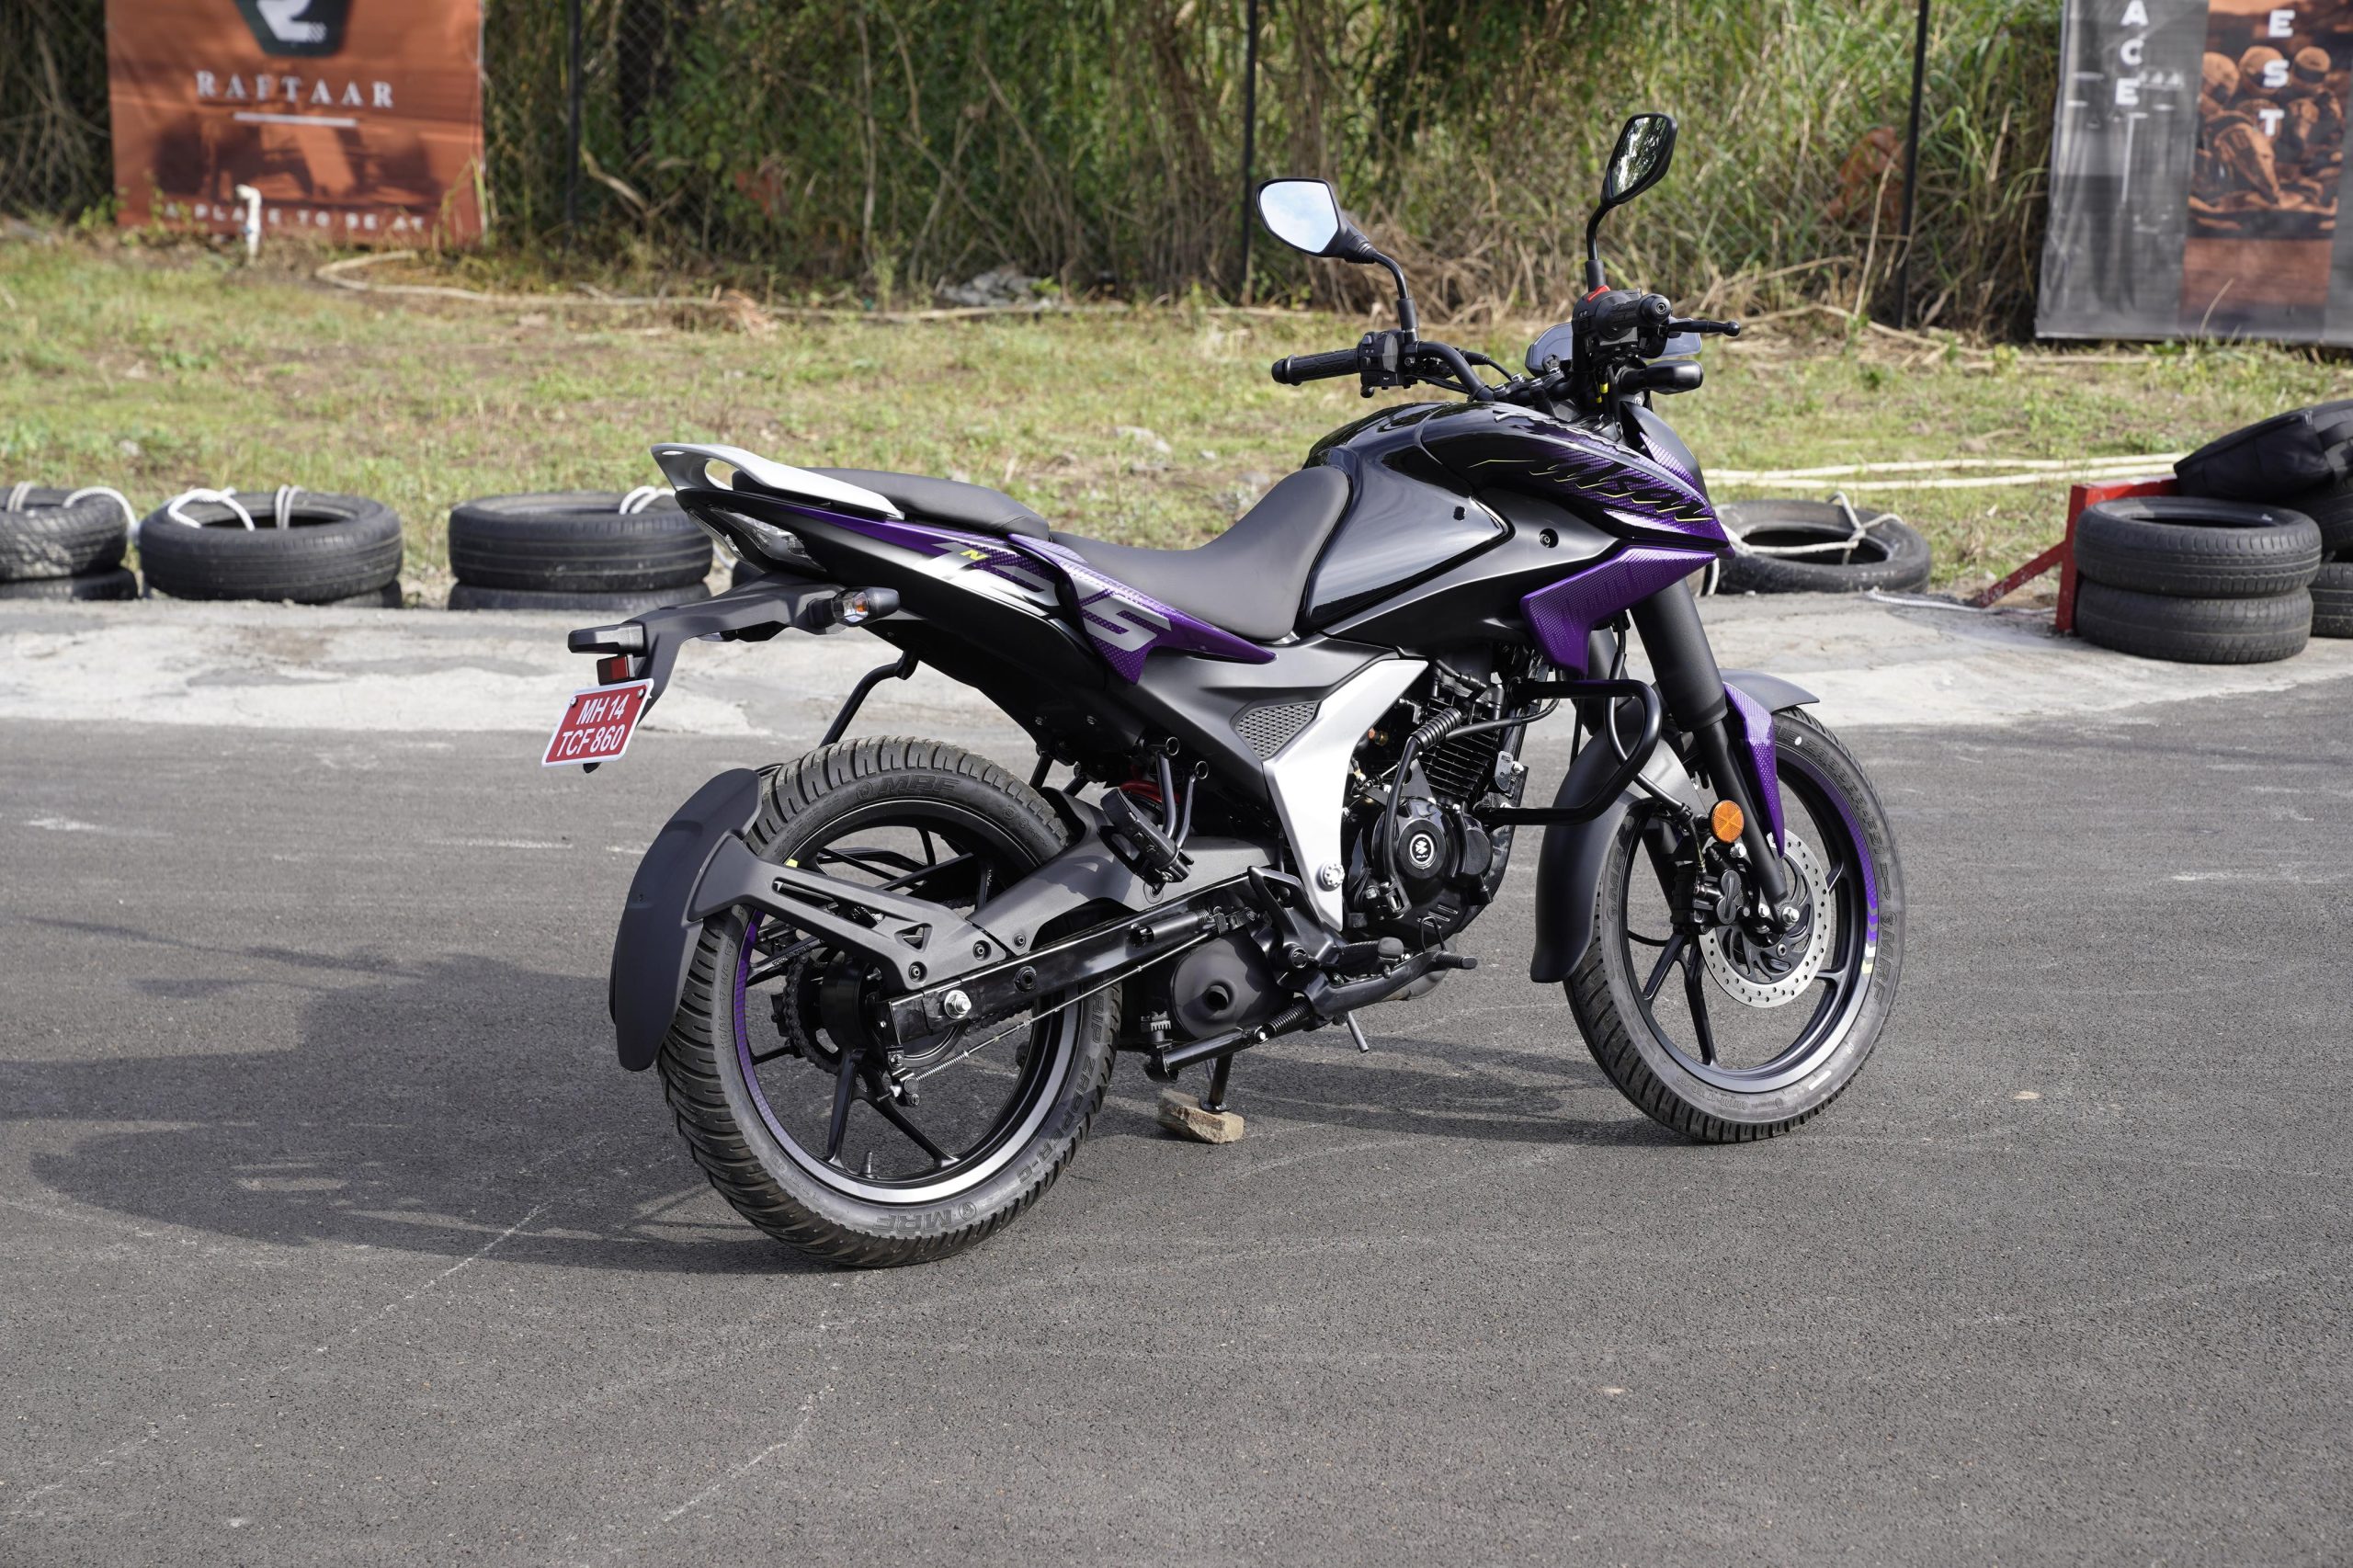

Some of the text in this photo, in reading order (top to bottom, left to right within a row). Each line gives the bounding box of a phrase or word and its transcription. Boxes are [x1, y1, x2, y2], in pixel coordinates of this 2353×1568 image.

[194, 203, 281, 225] PLAE
[575, 694, 631, 725] MH 14
[556, 723, 626, 757] TCF 860
[880, 774, 961, 794] MRF
[1873, 931, 1895, 1006] MRF
[872, 1210, 952, 1231] MRF
